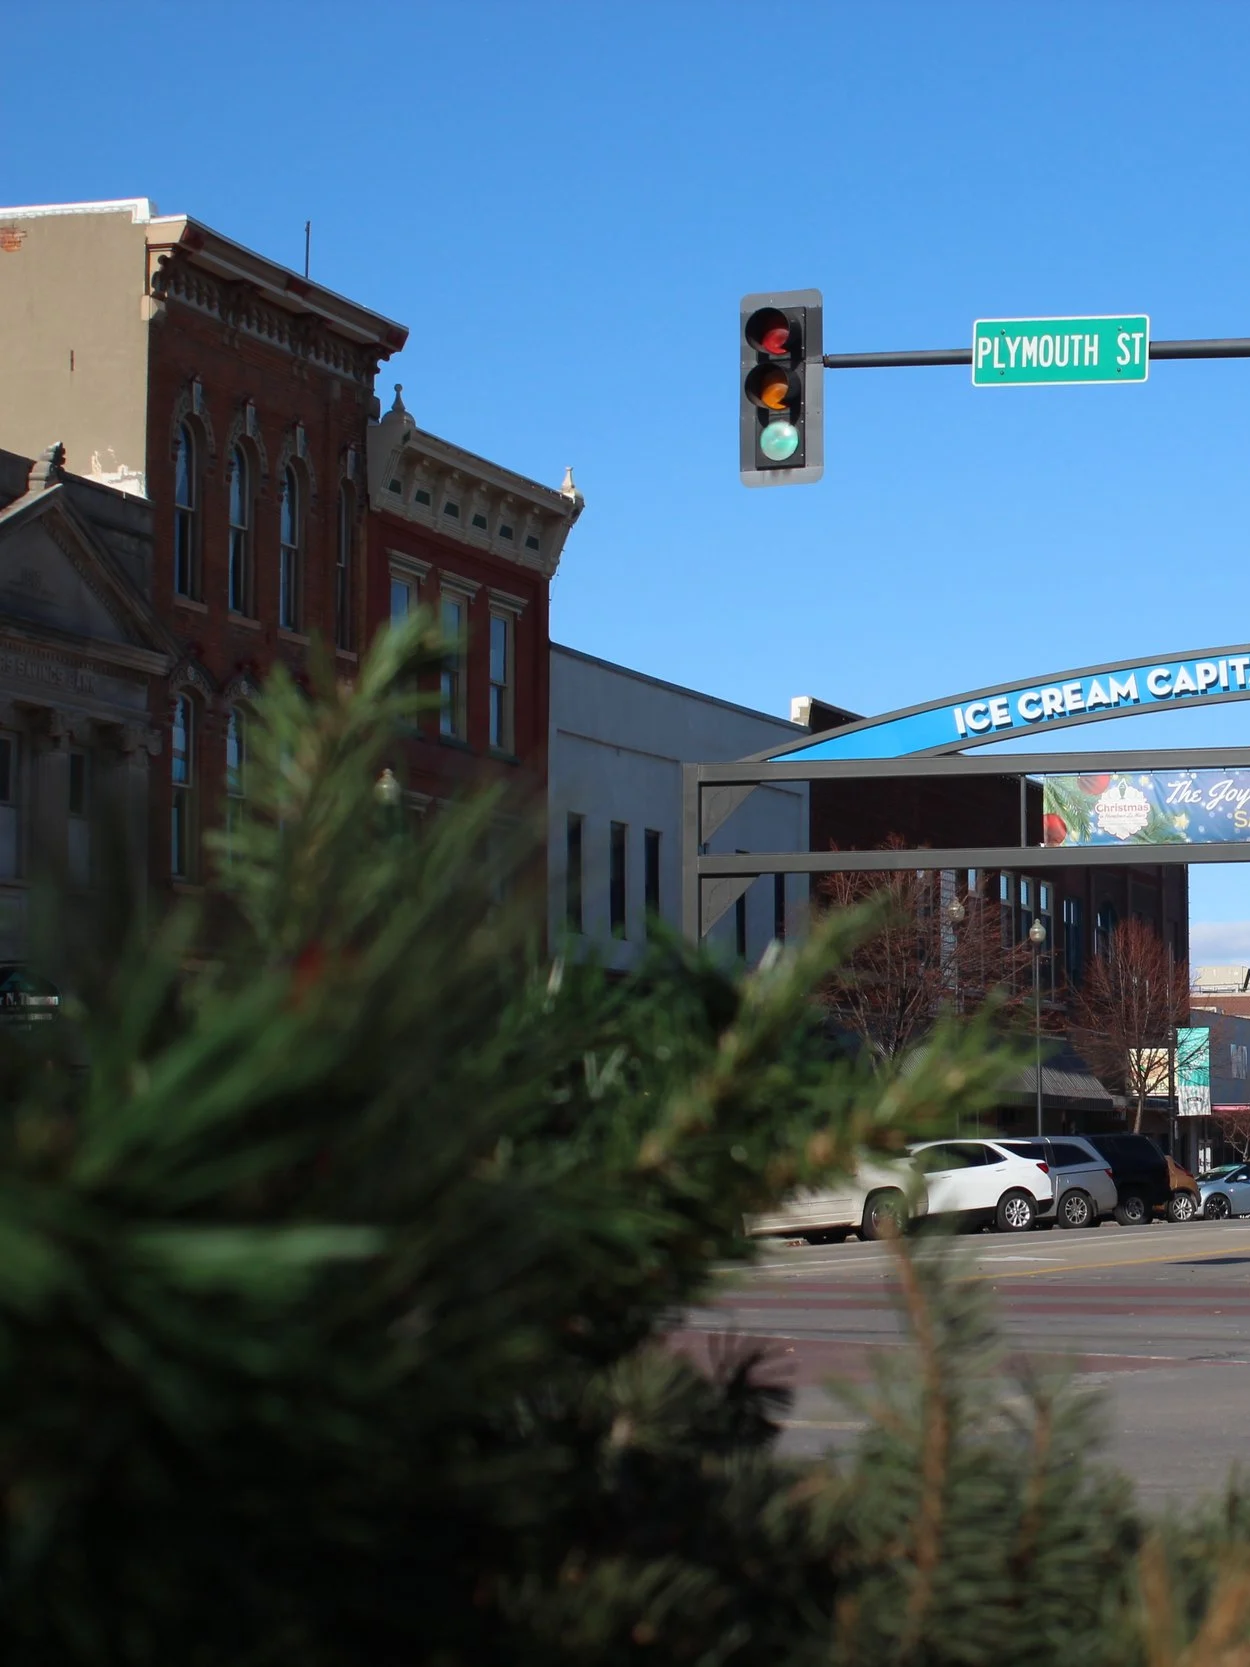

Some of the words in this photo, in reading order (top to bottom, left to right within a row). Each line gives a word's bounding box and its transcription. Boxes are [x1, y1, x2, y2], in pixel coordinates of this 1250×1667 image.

[977, 334, 1099, 369] PLYMOUTH
[1116, 332, 1144, 366] ST
[953, 697, 1012, 735] ICE
[1017, 672, 1139, 721] CREAM
[1096, 802, 1149, 812] Christmas
[1166, 779, 1202, 804] The
[1206, 779, 1250, 811] Joy
